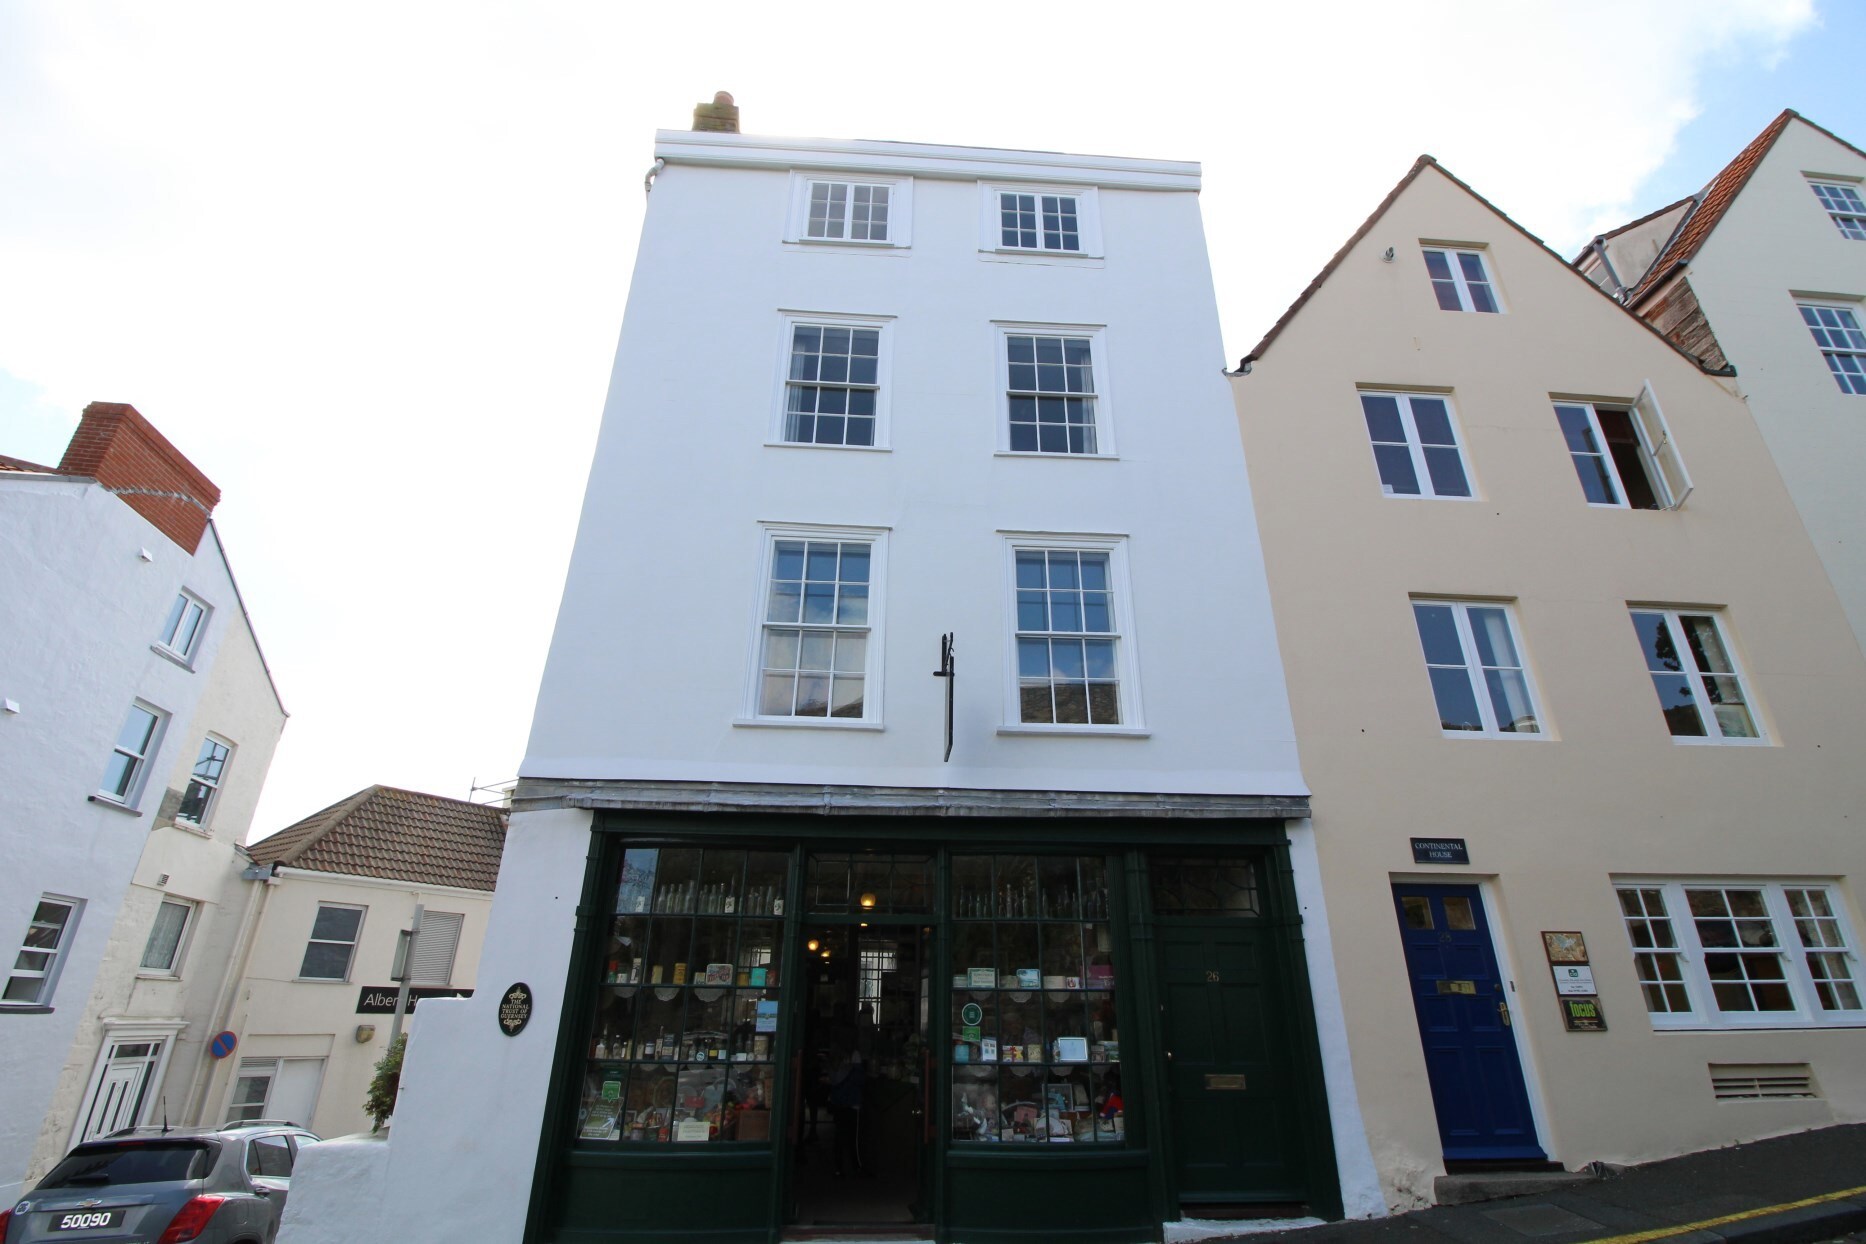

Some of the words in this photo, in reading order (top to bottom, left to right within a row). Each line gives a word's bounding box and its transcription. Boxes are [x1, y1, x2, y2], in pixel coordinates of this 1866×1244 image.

[1415, 842, 1463, 850] CONTINENTAL
[1206, 970, 1220, 982] 26
[364, 992, 400, 1007] Alber
[1569, 1001, 1597, 1017] focus
[60, 1212, 111, 1229] 50090
